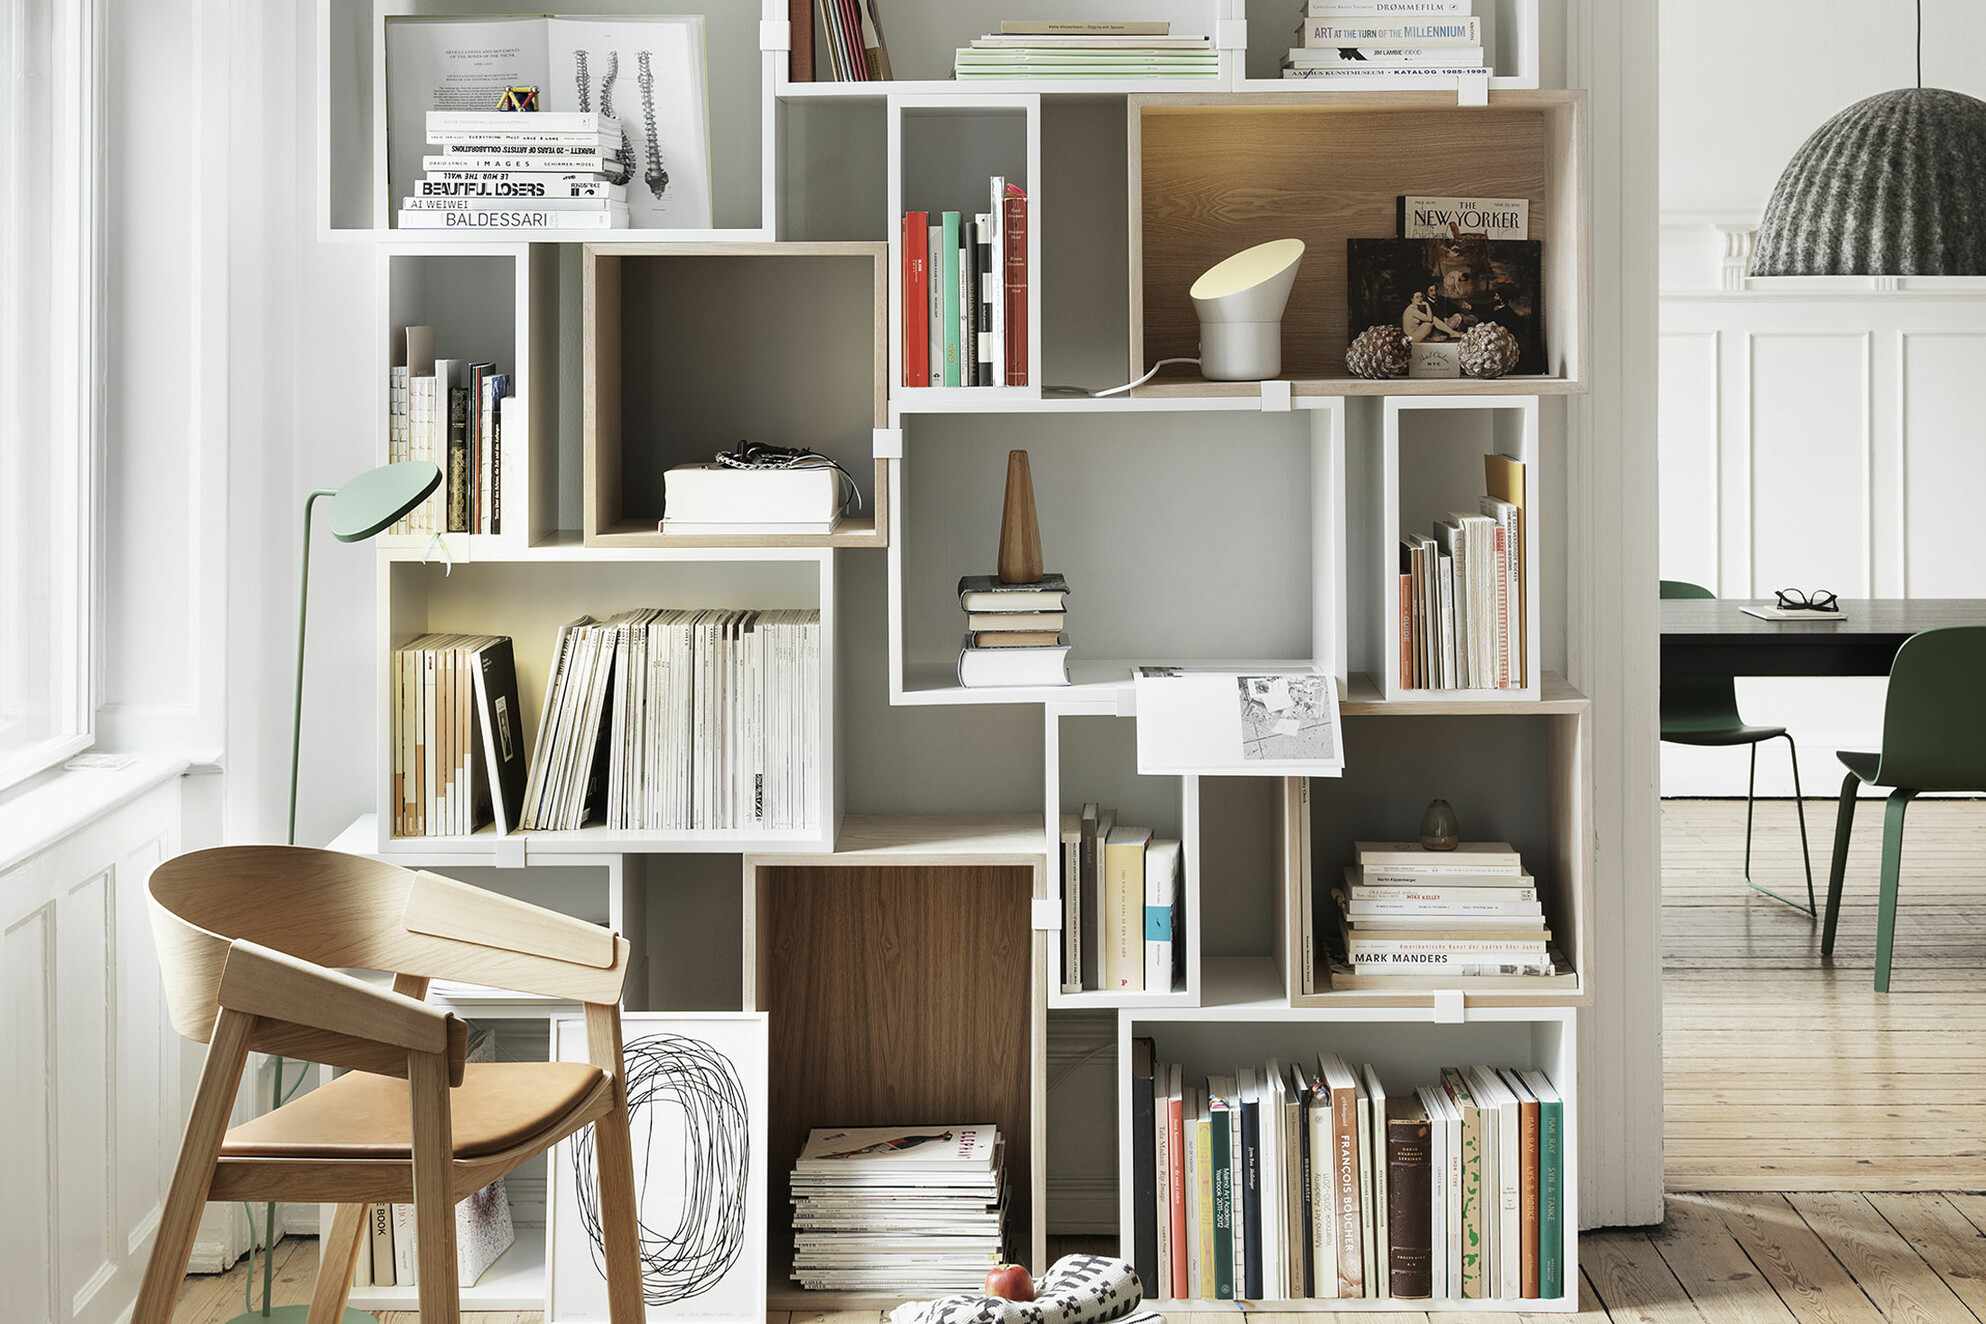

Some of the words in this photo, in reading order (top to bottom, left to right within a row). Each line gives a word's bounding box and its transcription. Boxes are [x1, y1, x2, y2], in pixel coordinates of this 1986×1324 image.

[1314, 27, 1332, 39] ART
[1333, 29, 1343, 39] AT
[1344, 29, 1356, 39] THE
[1358, 29, 1377, 38] TURN
[1378, 29, 1388, 38] OF
[1389, 29, 1402, 38] THE
[1404, 26, 1466, 38] MILLENNIUM
[422, 182, 492, 196] BEAUTIFUL
[495, 183, 545, 196] LOSERS
[446, 213, 548, 227] BALDESSARI
[1414, 210, 1452, 226] NEW
[1454, 210, 1520, 229] YORKER
[1355, 954, 1388, 963] MARK
[1392, 954, 1448, 963] MANDERS
[1341, 1135, 1352, 1193] FRANÇOIS
[377, 1208, 386, 1236] BOOK
[1324, 1214, 1332, 1247] Yearbook
[1342, 1196, 1354, 1252] BOUCHER
